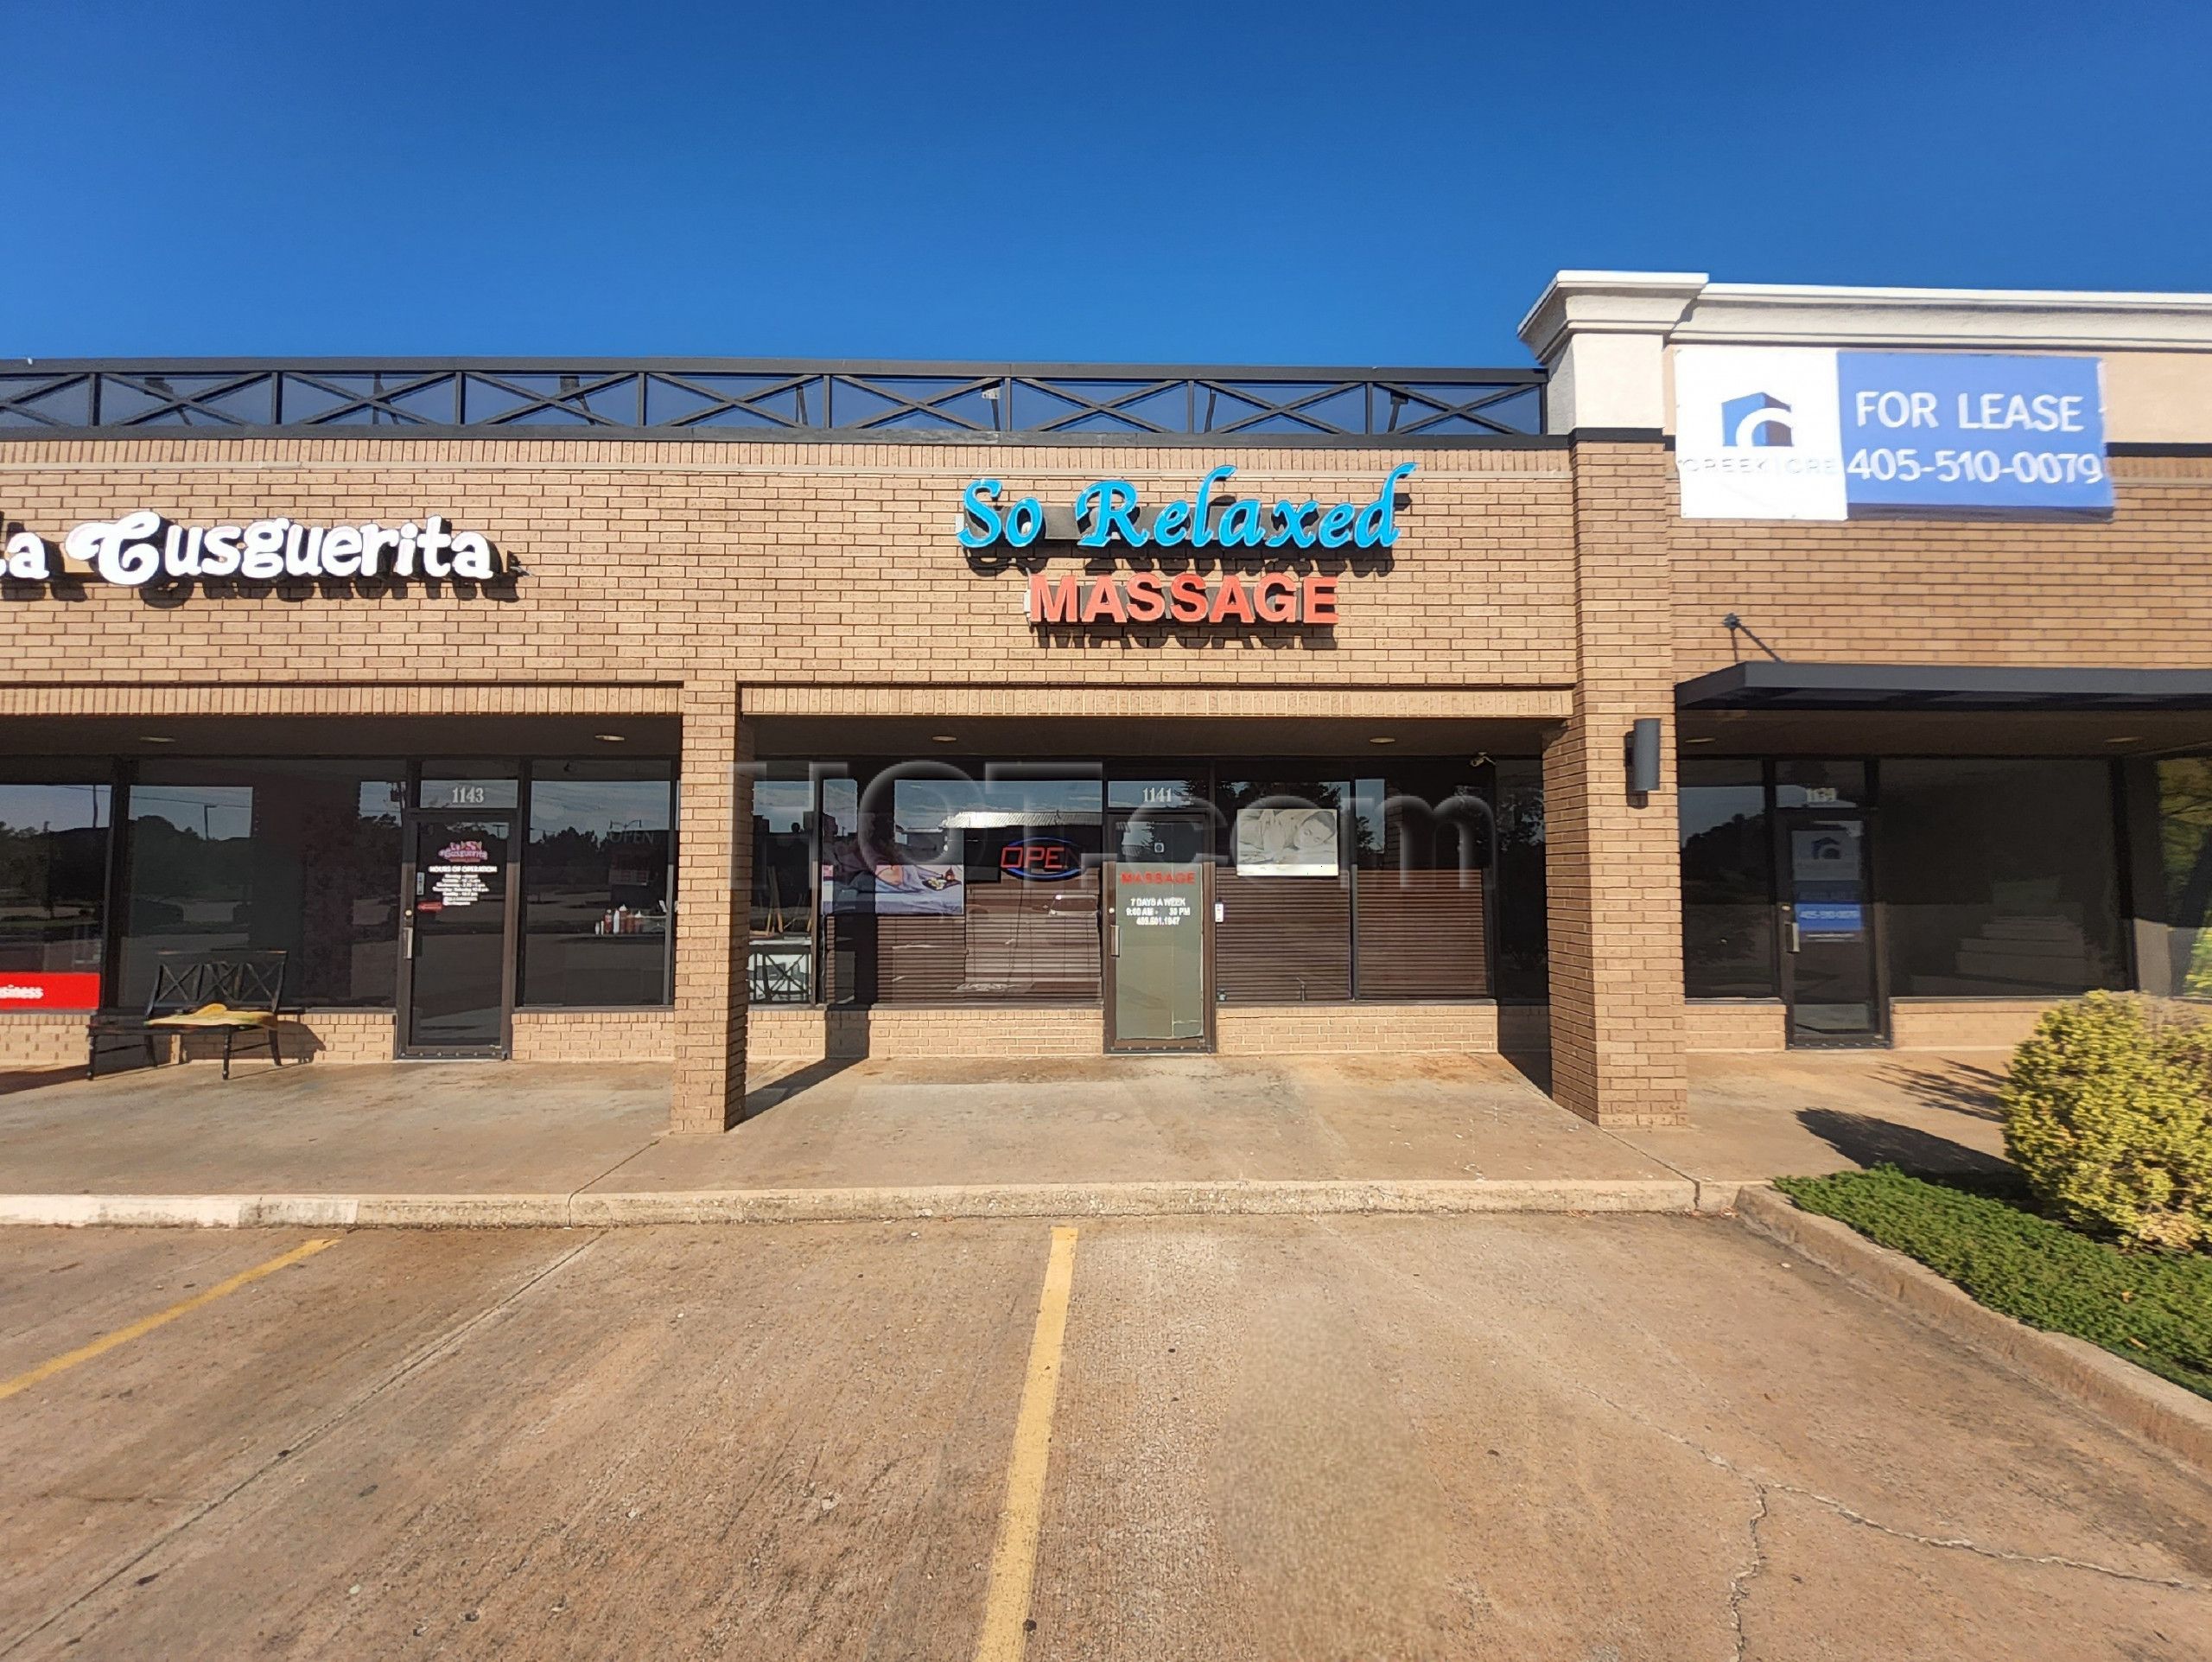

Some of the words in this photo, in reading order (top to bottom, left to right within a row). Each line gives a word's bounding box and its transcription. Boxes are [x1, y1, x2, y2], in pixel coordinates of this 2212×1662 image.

[1855, 391, 1937, 430] FOR
[1957, 392, 2085, 433] LEASE
[1847, 448, 2104, 485] 405-510-0079
[956, 479, 1045, 550] So
[1074, 462, 1419, 550] Relaxed
[0, 532, 50, 579] a
[1029, 572, 1339, 625] MASSAGE
[452, 786, 484, 804] 1143
[1142, 787, 1172, 803] 1141
[1121, 871, 1196, 884] MASSAGE
[1130, 897, 1136, 907] 7
[1136, 897, 1156, 907] DAYS
[1157, 897, 1163, 907] A
[1163, 897, 1186, 907] WEEK
[1179, 907, 1191, 916] PM
